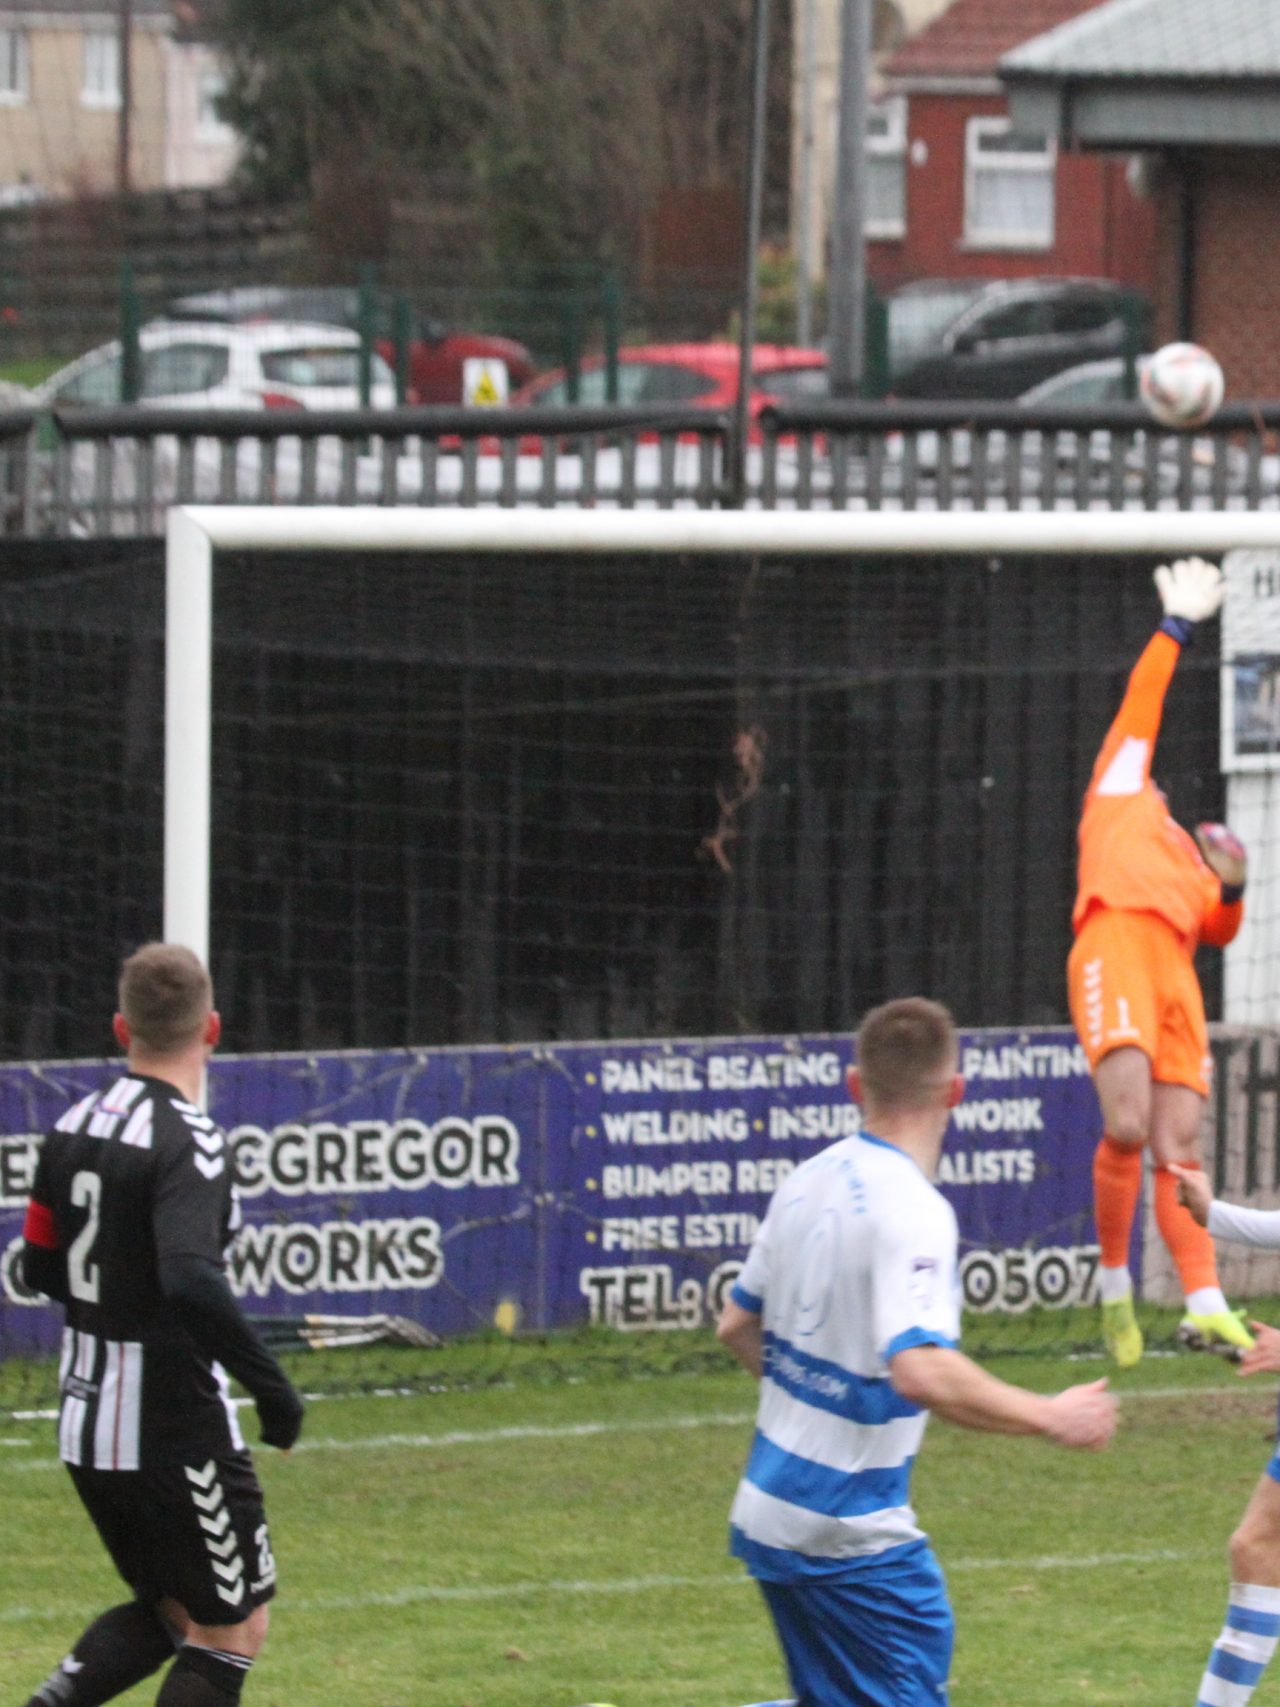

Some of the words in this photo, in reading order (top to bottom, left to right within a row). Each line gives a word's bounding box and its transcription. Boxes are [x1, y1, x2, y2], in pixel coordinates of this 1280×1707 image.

[1106, 996, 1140, 1040] 1
[602, 1059, 703, 1093] PANEL
[708, 1053, 841, 1091] BEATING
[962, 1044, 1093, 1081] PAINTIN
[603, 1108, 749, 1146] WELDING
[768, 1103, 864, 1141] INSUR
[953, 1098, 1044, 1132] WORK
[227, 1115, 520, 1198] CGREGOR
[602, 1161, 732, 1199] BUMPER
[934, 1149, 1035, 1185] ALISTS
[67, 1169, 102, 1304] 2
[602, 1215, 680, 1251] FREE
[579, 1263, 703, 1332] TEL:
[958, 1245, 1102, 1314] 0507
